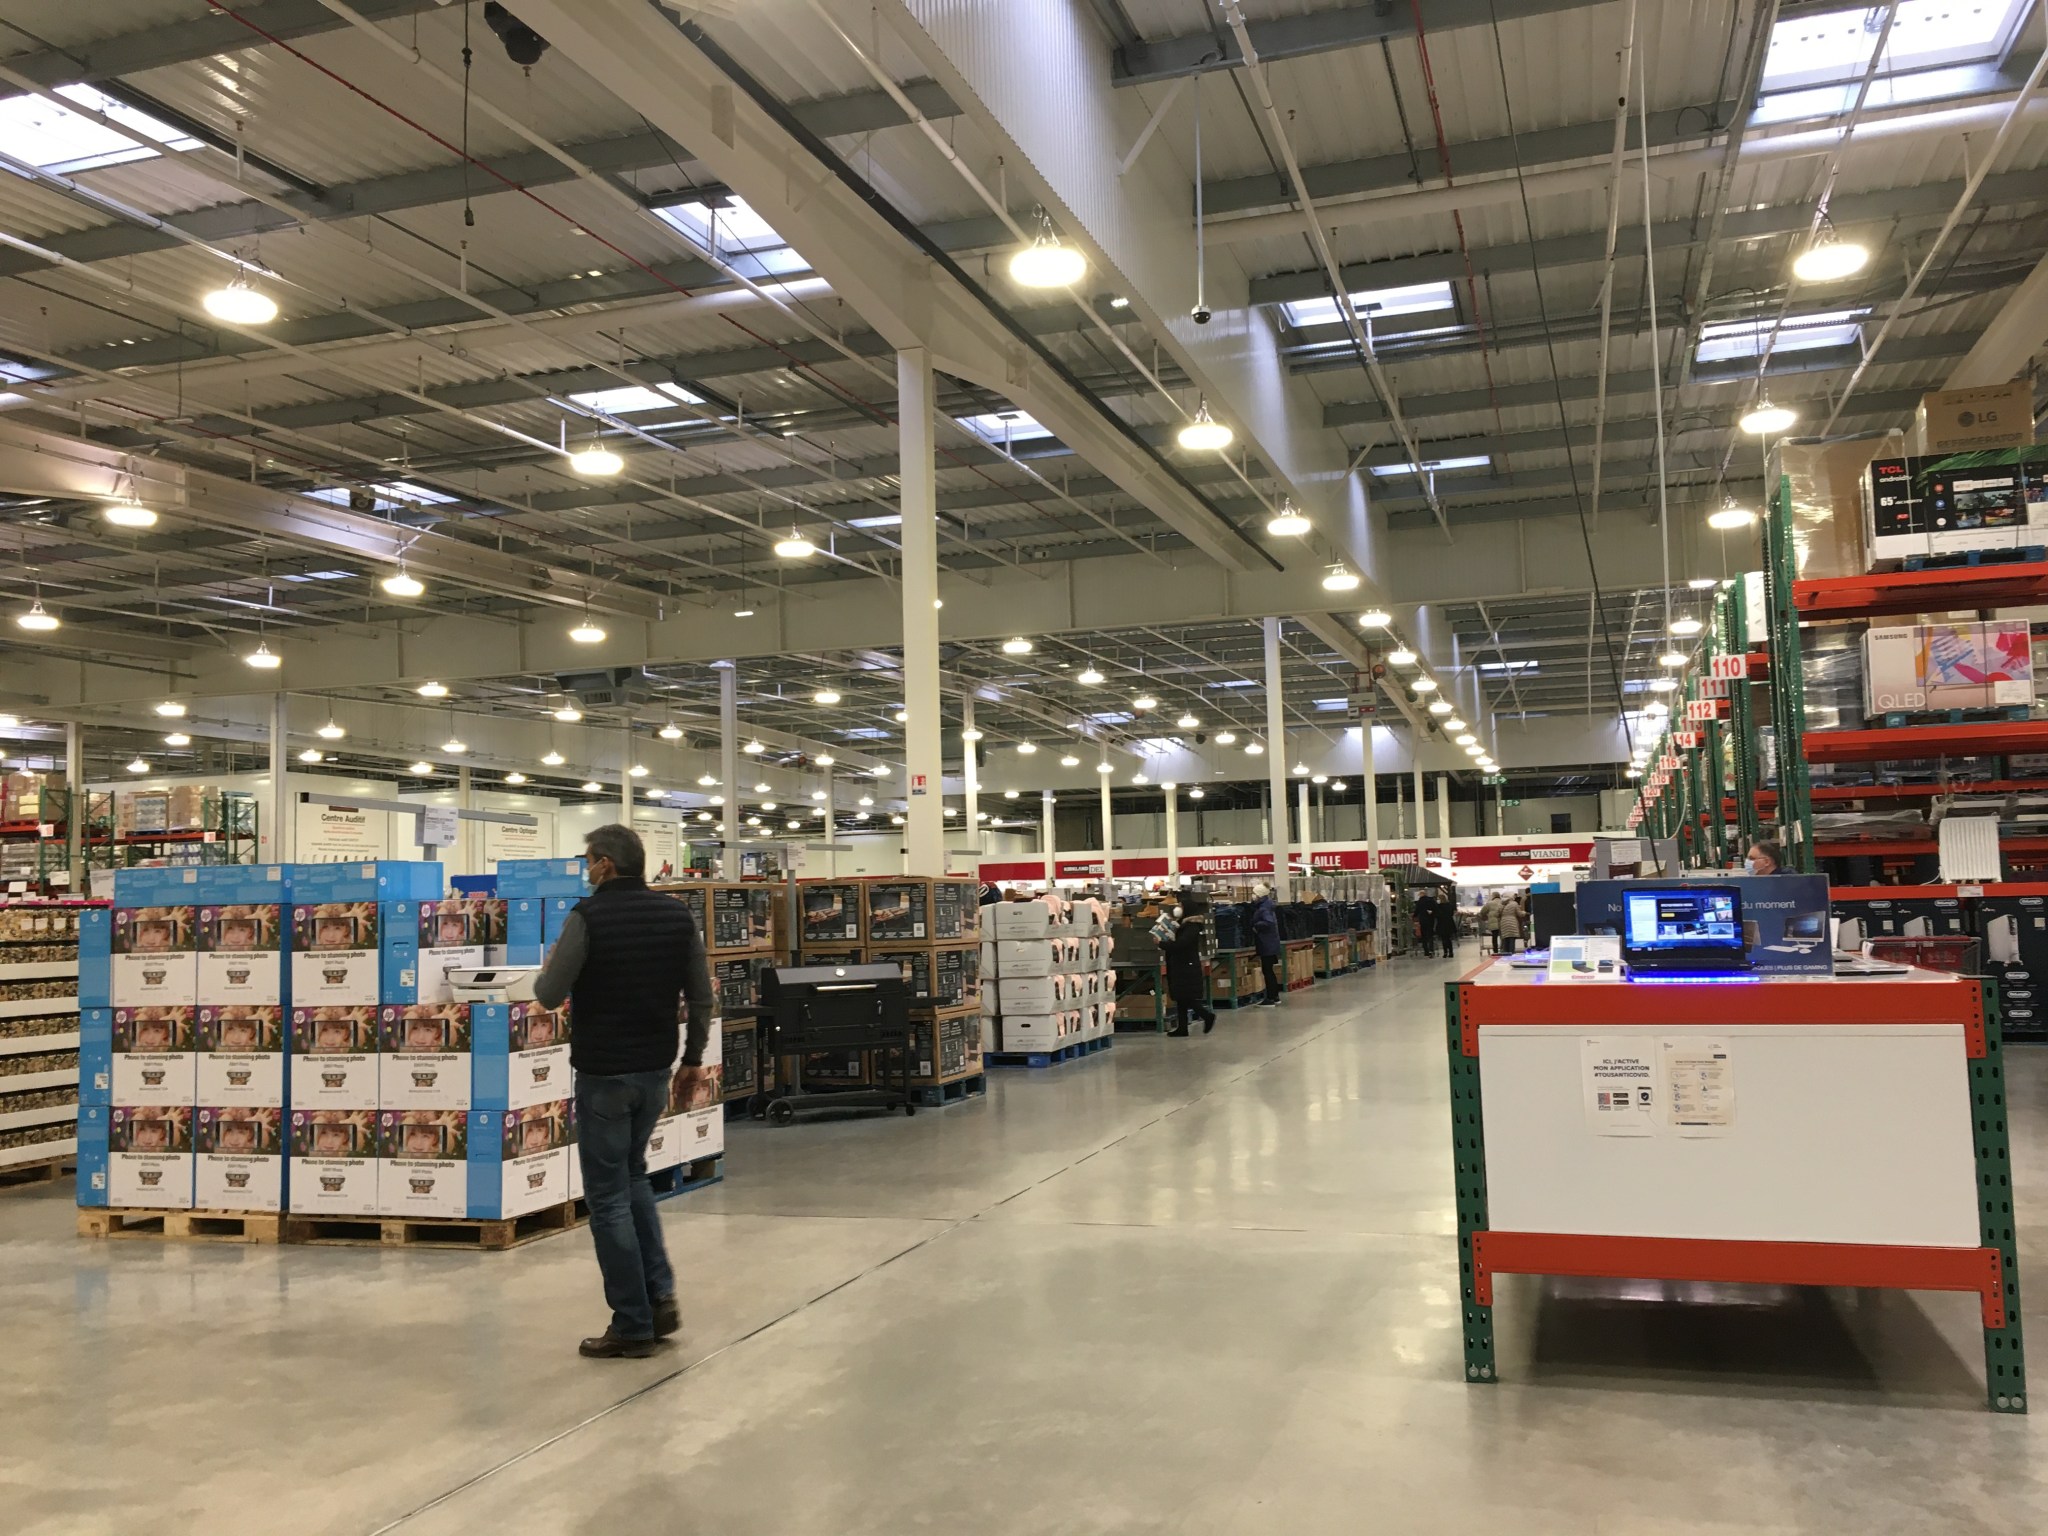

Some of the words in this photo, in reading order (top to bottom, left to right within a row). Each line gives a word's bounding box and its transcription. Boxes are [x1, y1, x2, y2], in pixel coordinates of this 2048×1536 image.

[1979, 412, 1997, 423] LG
[1878, 466, 1904, 474] TCL
[1712, 657, 1741, 677] 110
[1702, 679, 1726, 696] 111
[1878, 692, 1926, 709] QLED
[1689, 702, 1711, 718] 112
[1661, 757, 1676, 767] 116
[321, 813, 343, 822] Centre
[1196, 857, 1258, 871] POULET-RÔTI
[1380, 853, 1417, 864] VIANDE
[1756, 901, 1796, 909] moment
